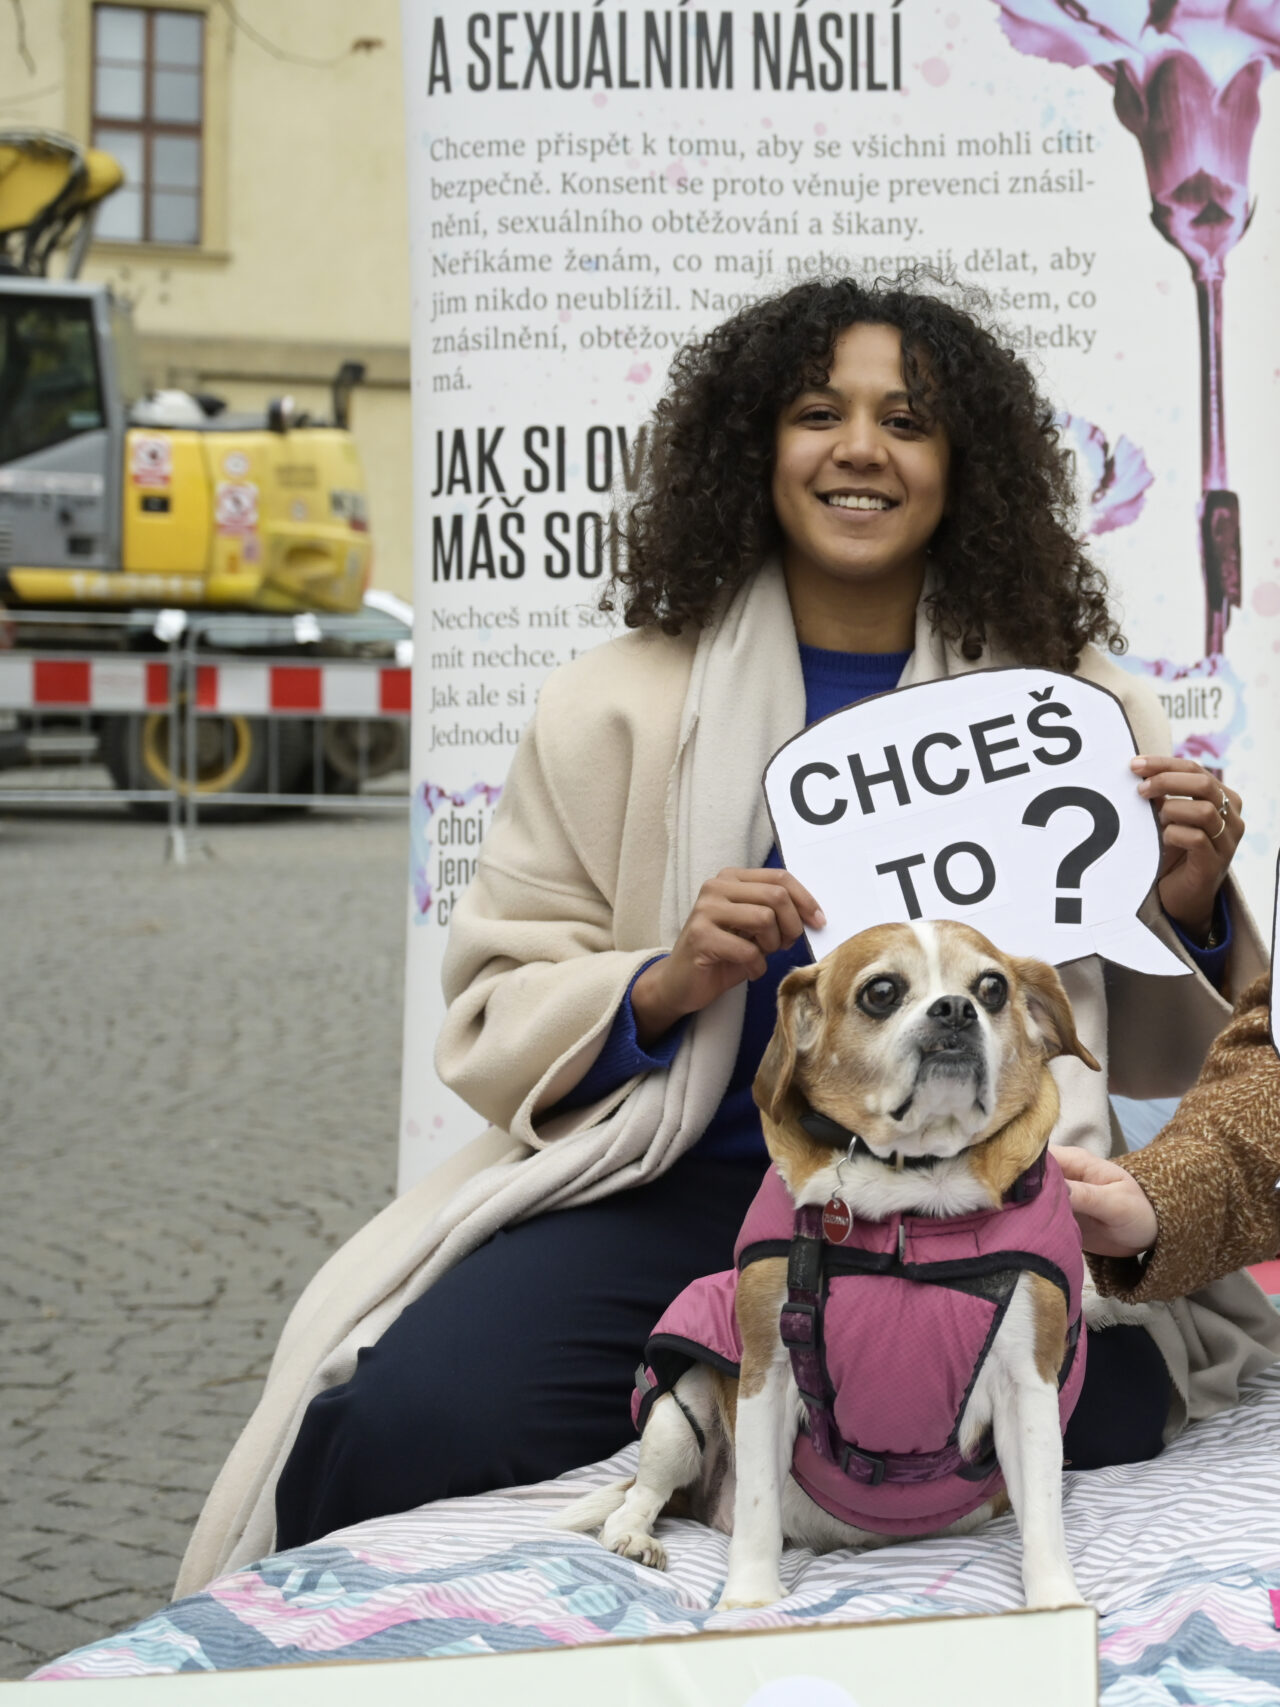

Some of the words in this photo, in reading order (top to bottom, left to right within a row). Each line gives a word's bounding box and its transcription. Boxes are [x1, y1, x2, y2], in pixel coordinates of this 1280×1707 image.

[428, 16, 452, 97] A
[467, 0, 733, 92] SEXUÁLNÍM
[753, 0, 901, 91] NÁSILÍ
[430, 136, 526, 162] Chceme
[537, 132, 630, 162] přispět
[642, 132, 656, 157] k
[668, 135, 745, 161] tomu,
[757, 134, 803, 164] aby
[814, 138, 841, 158] se
[852, 133, 945, 158] všichni
[957, 132, 1031, 156] mohli
[1042, 130, 1095, 154] cítit
[430, 171, 551, 203] bezpečně.
[561, 171, 667, 195] Konsent
[676, 176, 704, 195] se
[713, 174, 784, 202] proto
[793, 172, 880, 203] věnuje
[889, 171, 1000, 203] prevenci
[1008, 168, 1095, 195] znásil-
[432, 211, 488, 239] nění,
[497, 209, 643, 235] sexuálního
[652, 208, 799, 235] obtěžování
[808, 216, 823, 235] a
[832, 211, 924, 241] šikany.
[432, 250, 552, 278] Neříkáme
[564, 247, 660, 276] ženám,
[673, 254, 702, 273] co
[715, 248, 773, 279] mají
[965, 248, 1038, 275] dělat,
[1049, 246, 1097, 277] aby
[430, 292, 468, 322] jim
[475, 287, 548, 312] nikdo
[556, 285, 681, 312] neublížil.
[1067, 290, 1097, 309] co
[432, 325, 568, 354] znásilnění,
[432, 367, 472, 393] má.
[431, 426, 506, 498] JAK
[523, 425, 566, 494] SI
[432, 496, 526, 583] MÁŠ
[431, 604, 520, 631] Nechceš
[528, 603, 571, 629] mít
[431, 644, 464, 670] mít
[429, 683, 460, 713] Jak
[466, 682, 499, 706] ale
[507, 682, 525, 706] si
[789, 686, 1083, 826] CHCEŠ
[437, 809, 483, 846] chci
[875, 840, 996, 920] TO
[1021, 786, 1120, 925] ?
